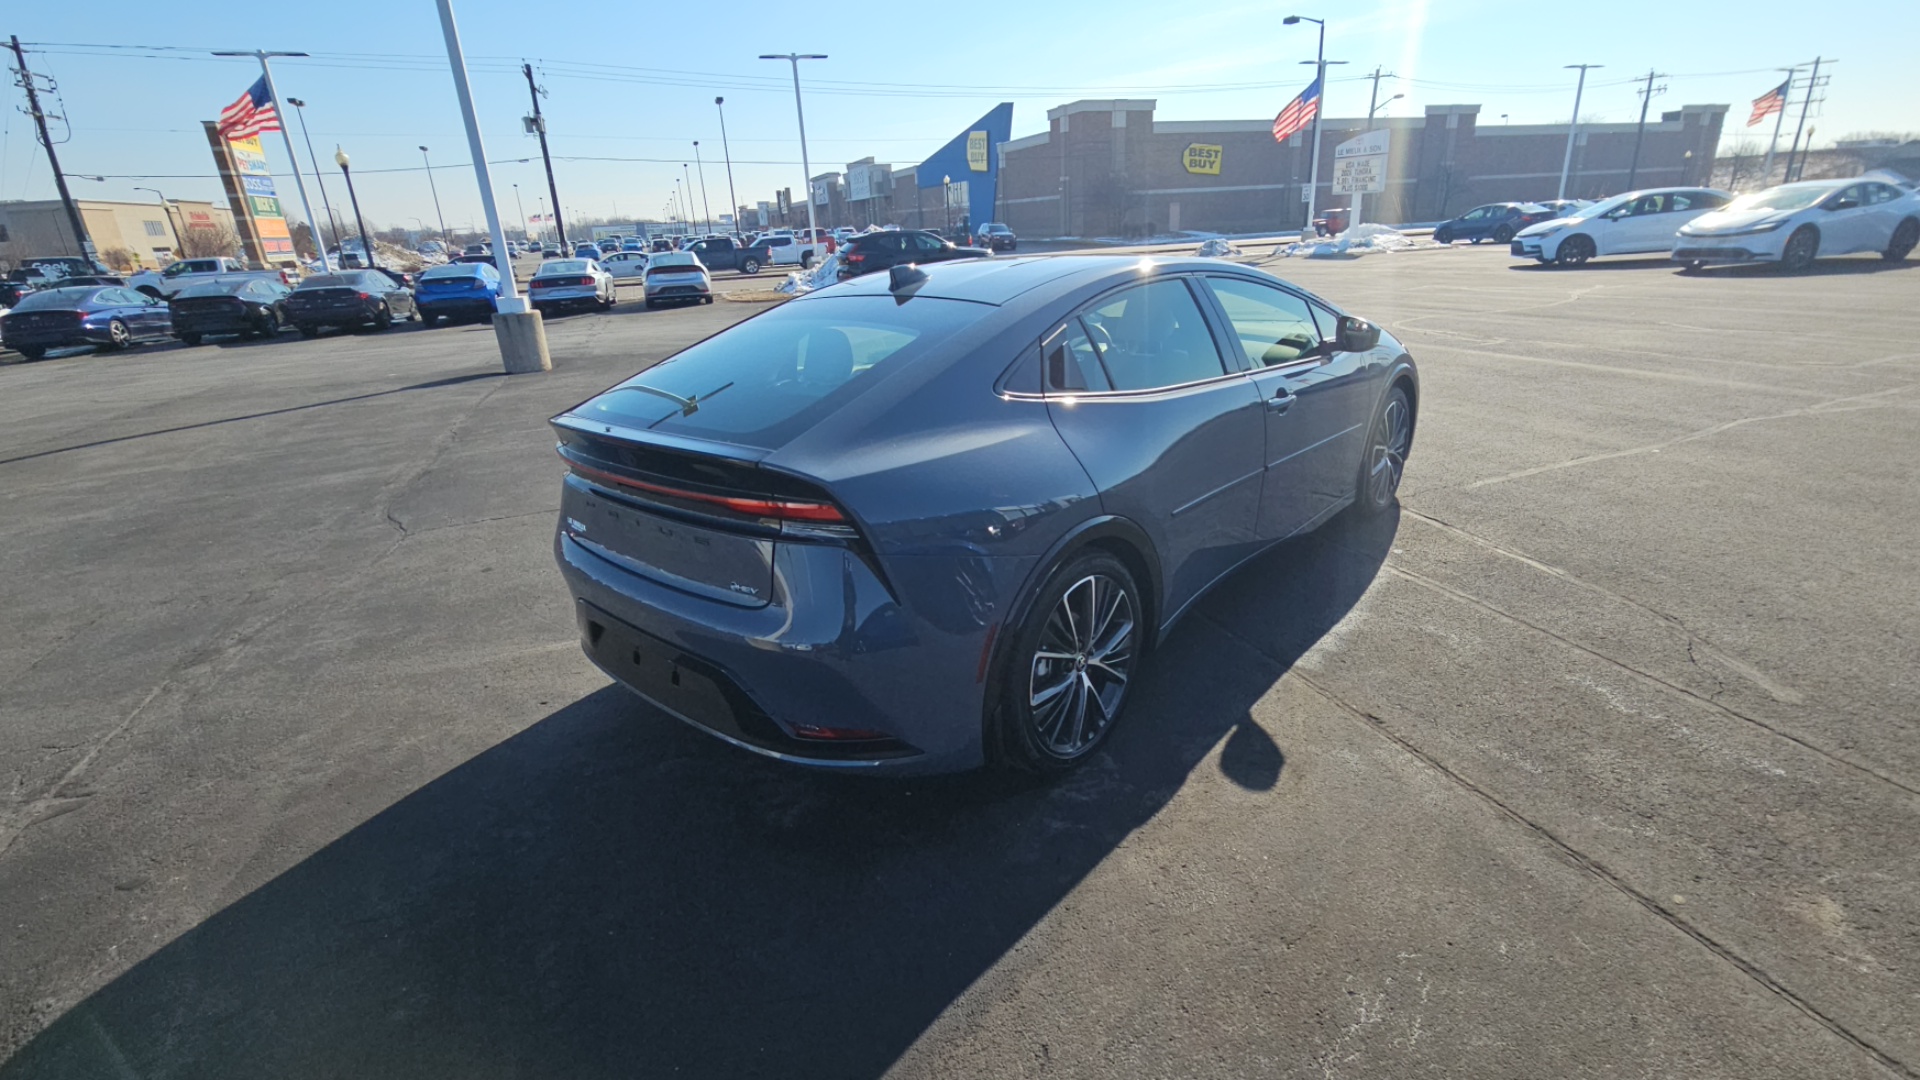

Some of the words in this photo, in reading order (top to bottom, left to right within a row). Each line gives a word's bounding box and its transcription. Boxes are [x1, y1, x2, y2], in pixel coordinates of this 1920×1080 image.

[969, 138, 986, 150] BEST
[1369, 144, 1382, 153] SON
[970, 151, 985, 164] BUY
[1189, 147, 1220, 159] BEST
[1189, 158, 1216, 170] BUY
